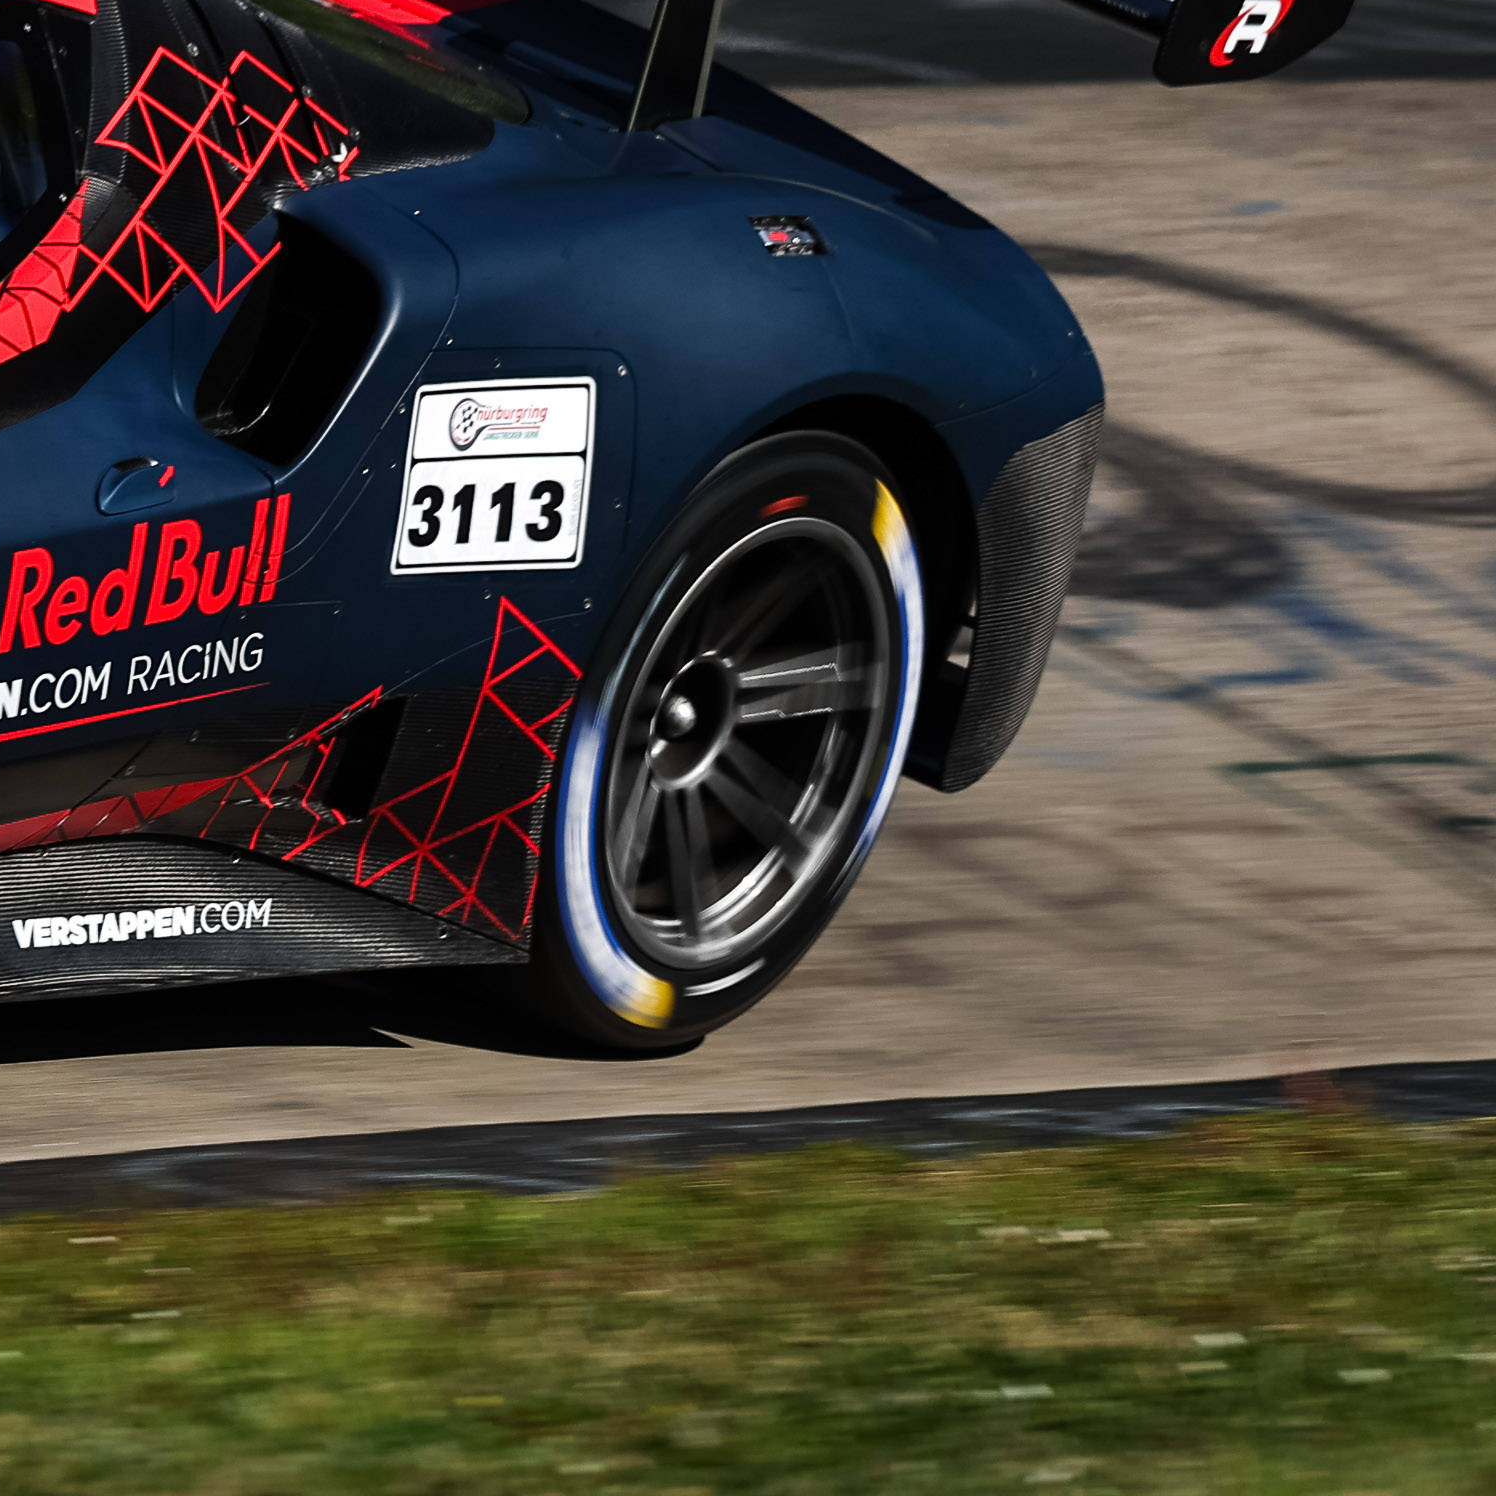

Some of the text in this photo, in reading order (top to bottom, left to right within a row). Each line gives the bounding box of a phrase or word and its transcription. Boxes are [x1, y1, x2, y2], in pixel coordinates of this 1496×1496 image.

[407, 478, 565, 548] 3113
[142, 491, 292, 627] Bull
[126, 631, 265, 696] RACING
[10, 897, 273, 950] VERSTAPPEN.COM
